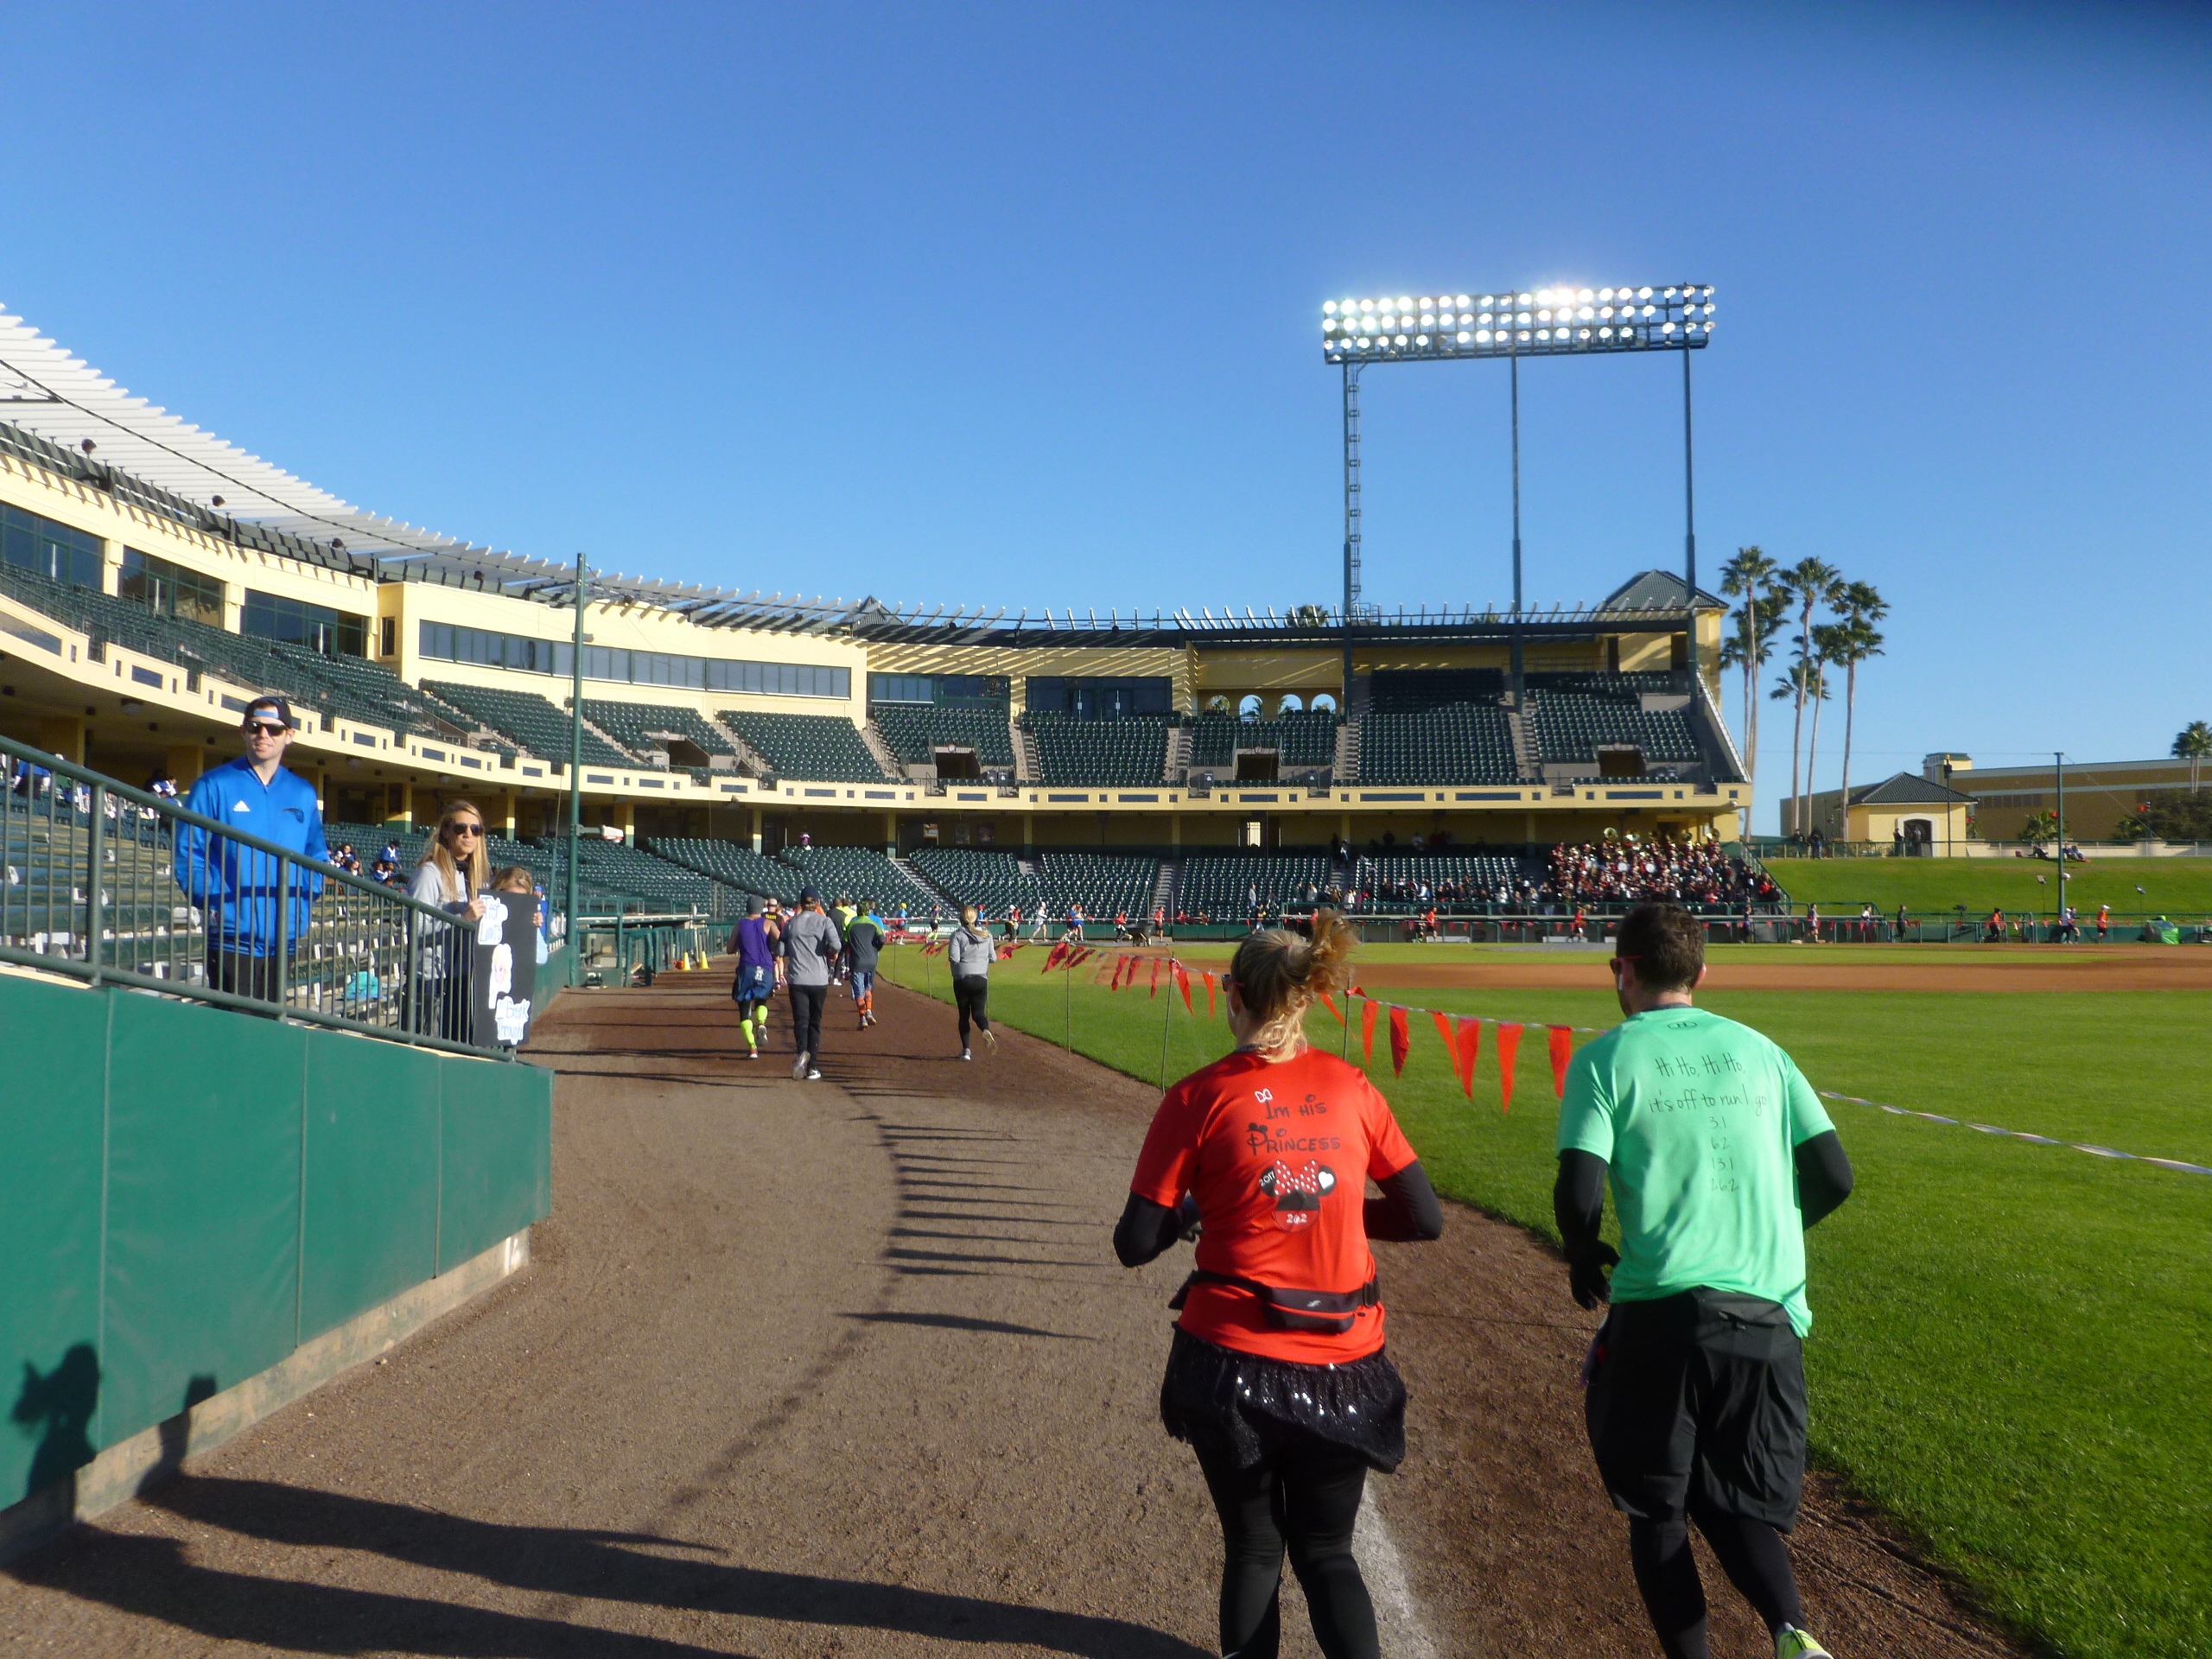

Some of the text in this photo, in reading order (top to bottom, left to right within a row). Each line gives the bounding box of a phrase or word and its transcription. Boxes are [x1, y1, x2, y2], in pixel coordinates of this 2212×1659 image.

[1654, 1057, 1675, 1078] Hi
[1701, 1054, 1720, 1076] Hi
[1676, 1088, 1697, 1110] off
[1700, 1093, 1717, 1108] to
[1719, 1094, 1742, 1106] run
[1754, 1096, 1767, 1116] go
